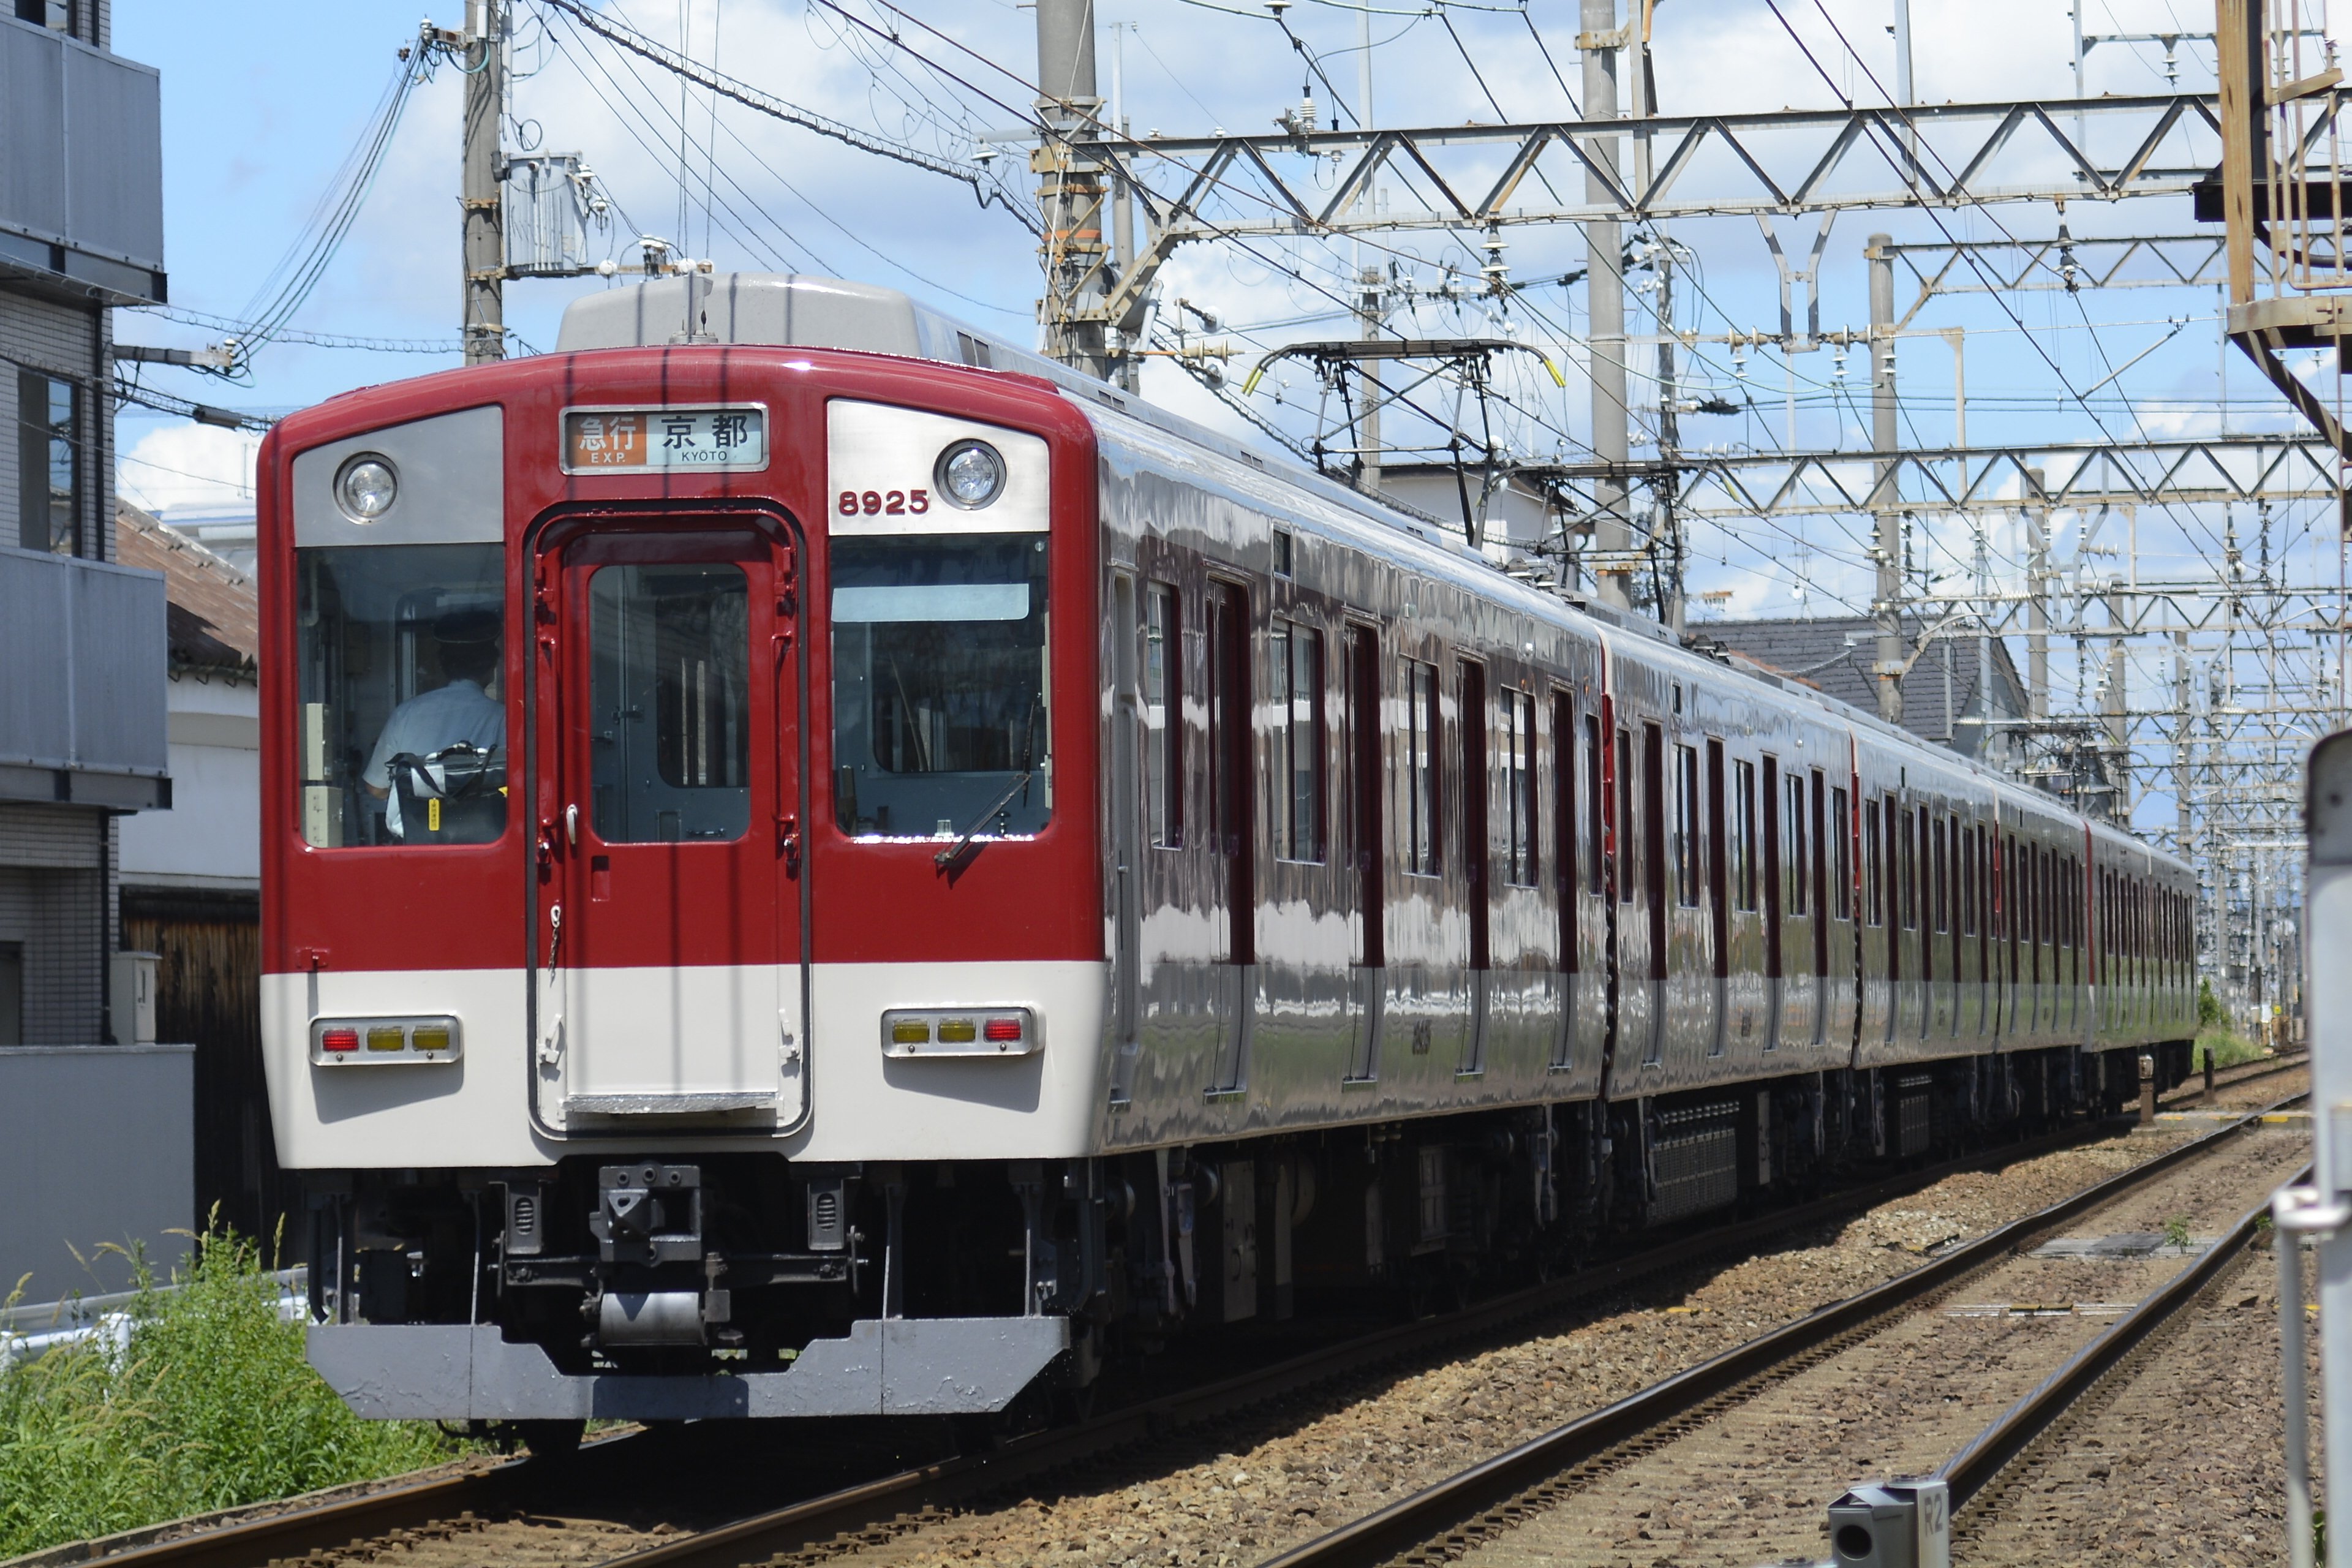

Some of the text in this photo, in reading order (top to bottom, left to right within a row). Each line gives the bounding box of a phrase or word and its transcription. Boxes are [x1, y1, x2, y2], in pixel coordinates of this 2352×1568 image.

[579, 417, 636, 451] 急行
[661, 415, 748, 450] 京都
[590, 452, 625, 463] EXP.
[839, 489, 929, 516] 8925
[1924, 1493, 1943, 1537] R2
